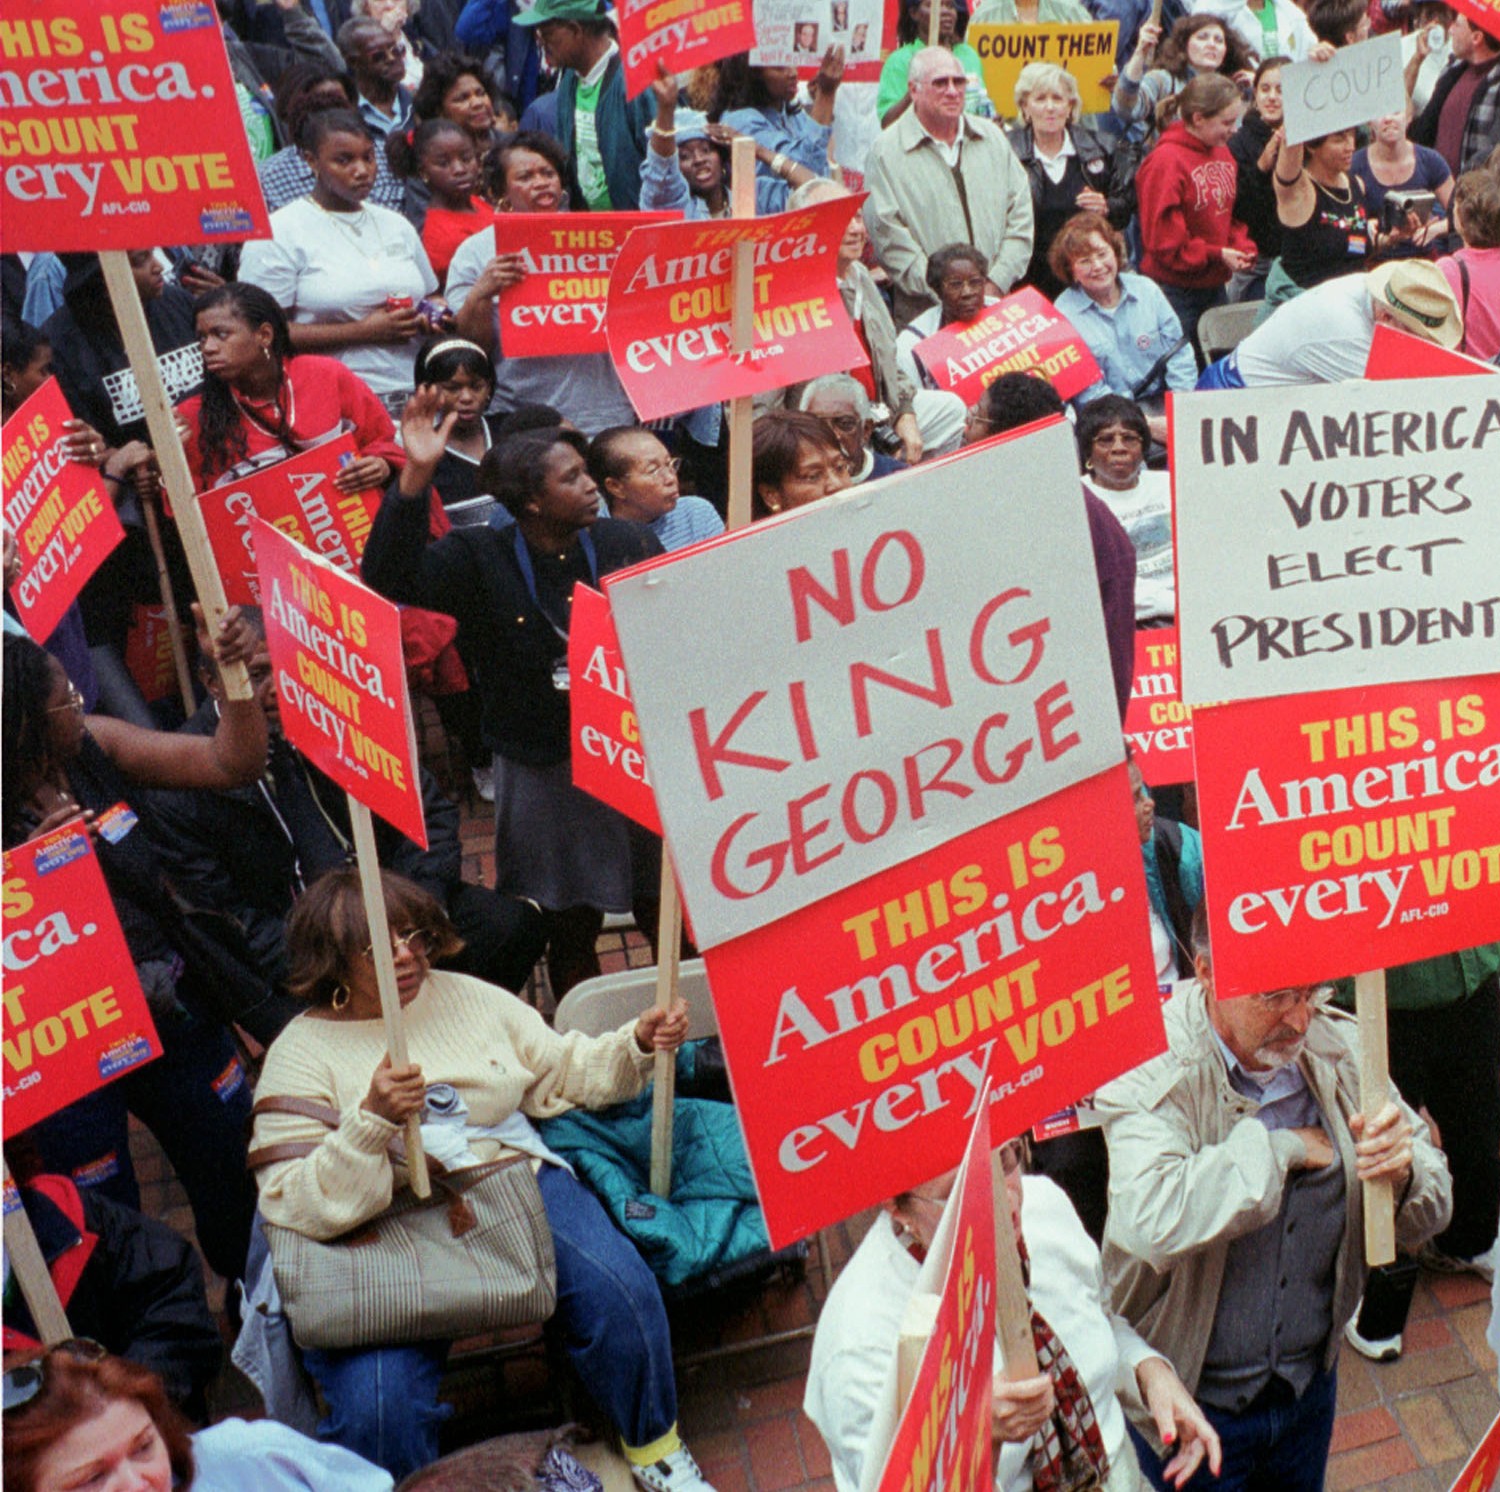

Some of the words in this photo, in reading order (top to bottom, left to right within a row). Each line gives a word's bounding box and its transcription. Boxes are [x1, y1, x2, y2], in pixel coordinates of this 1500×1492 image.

[0, 18, 84, 58] HIS
[100, 13, 155, 54] IS
[690, 2, 744, 34] VOTE
[977, 34, 1050, 58] COUNT
[1056, 32, 1112, 57] THEM
[1303, 55, 1393, 111] COUP
[0, 161, 104, 217] ery
[111, 153, 235, 194] VOTE
[102, 201, 151, 215] AFL-CIO
[551, 230, 615, 249] THIS
[693, 224, 771, 248] THIS
[781, 212, 817, 233] IS
[517, 246, 617, 275] Amer
[549, 278, 607, 300] COU
[623, 232, 828, 295] Ameica.
[510, 302, 608, 334] every
[669, 273, 774, 323] COUT
[753, 297, 833, 342] VOTE
[956, 315, 1004, 348] THIS
[1001, 303, 1027, 325] IS
[944, 313, 1058, 387] America.
[27, 414, 51, 449] IS
[1201, 414, 1258, 467] IN
[24, 486, 66, 557] COUNT
[288, 473, 356, 575] Amer
[1280, 471, 1473, 529] VOTERS
[18, 530, 69, 609] every
[60, 489, 103, 544] VOTE
[1267, 537, 1466, 590] ELECT
[289, 563, 334, 627] THIS
[340, 603, 368, 647] IS
[786, 530, 926, 643] NO
[270, 578, 396, 709] America.
[297, 650, 362, 725] COUNT
[688, 586, 1051, 802] KING
[279, 669, 346, 760] every
[350, 728, 408, 793] VOTE
[1123, 727, 1193, 756] ever
[1300, 705, 1420, 763] THIS
[1438, 694, 1486, 742] IS
[710, 681, 1082, 901] GEORGE
[1299, 806, 1457, 873] COUNT
[842, 863, 988, 961] THIS
[1006, 825, 1066, 889] IS
[1227, 863, 1414, 936] every
[1399, 902, 1450, 925] AFL-CIO
[762, 869, 1126, 1068] America.
[3, 986, 123, 1073] VOTE
[858, 959, 1041, 1084] COUNT
[2, 1071, 43, 1100] FL-CIO
[777, 1038, 999, 1174] every
[1003, 964, 1135, 1066] VOTE
[989, 1065, 1045, 1106] AFL-CIO
